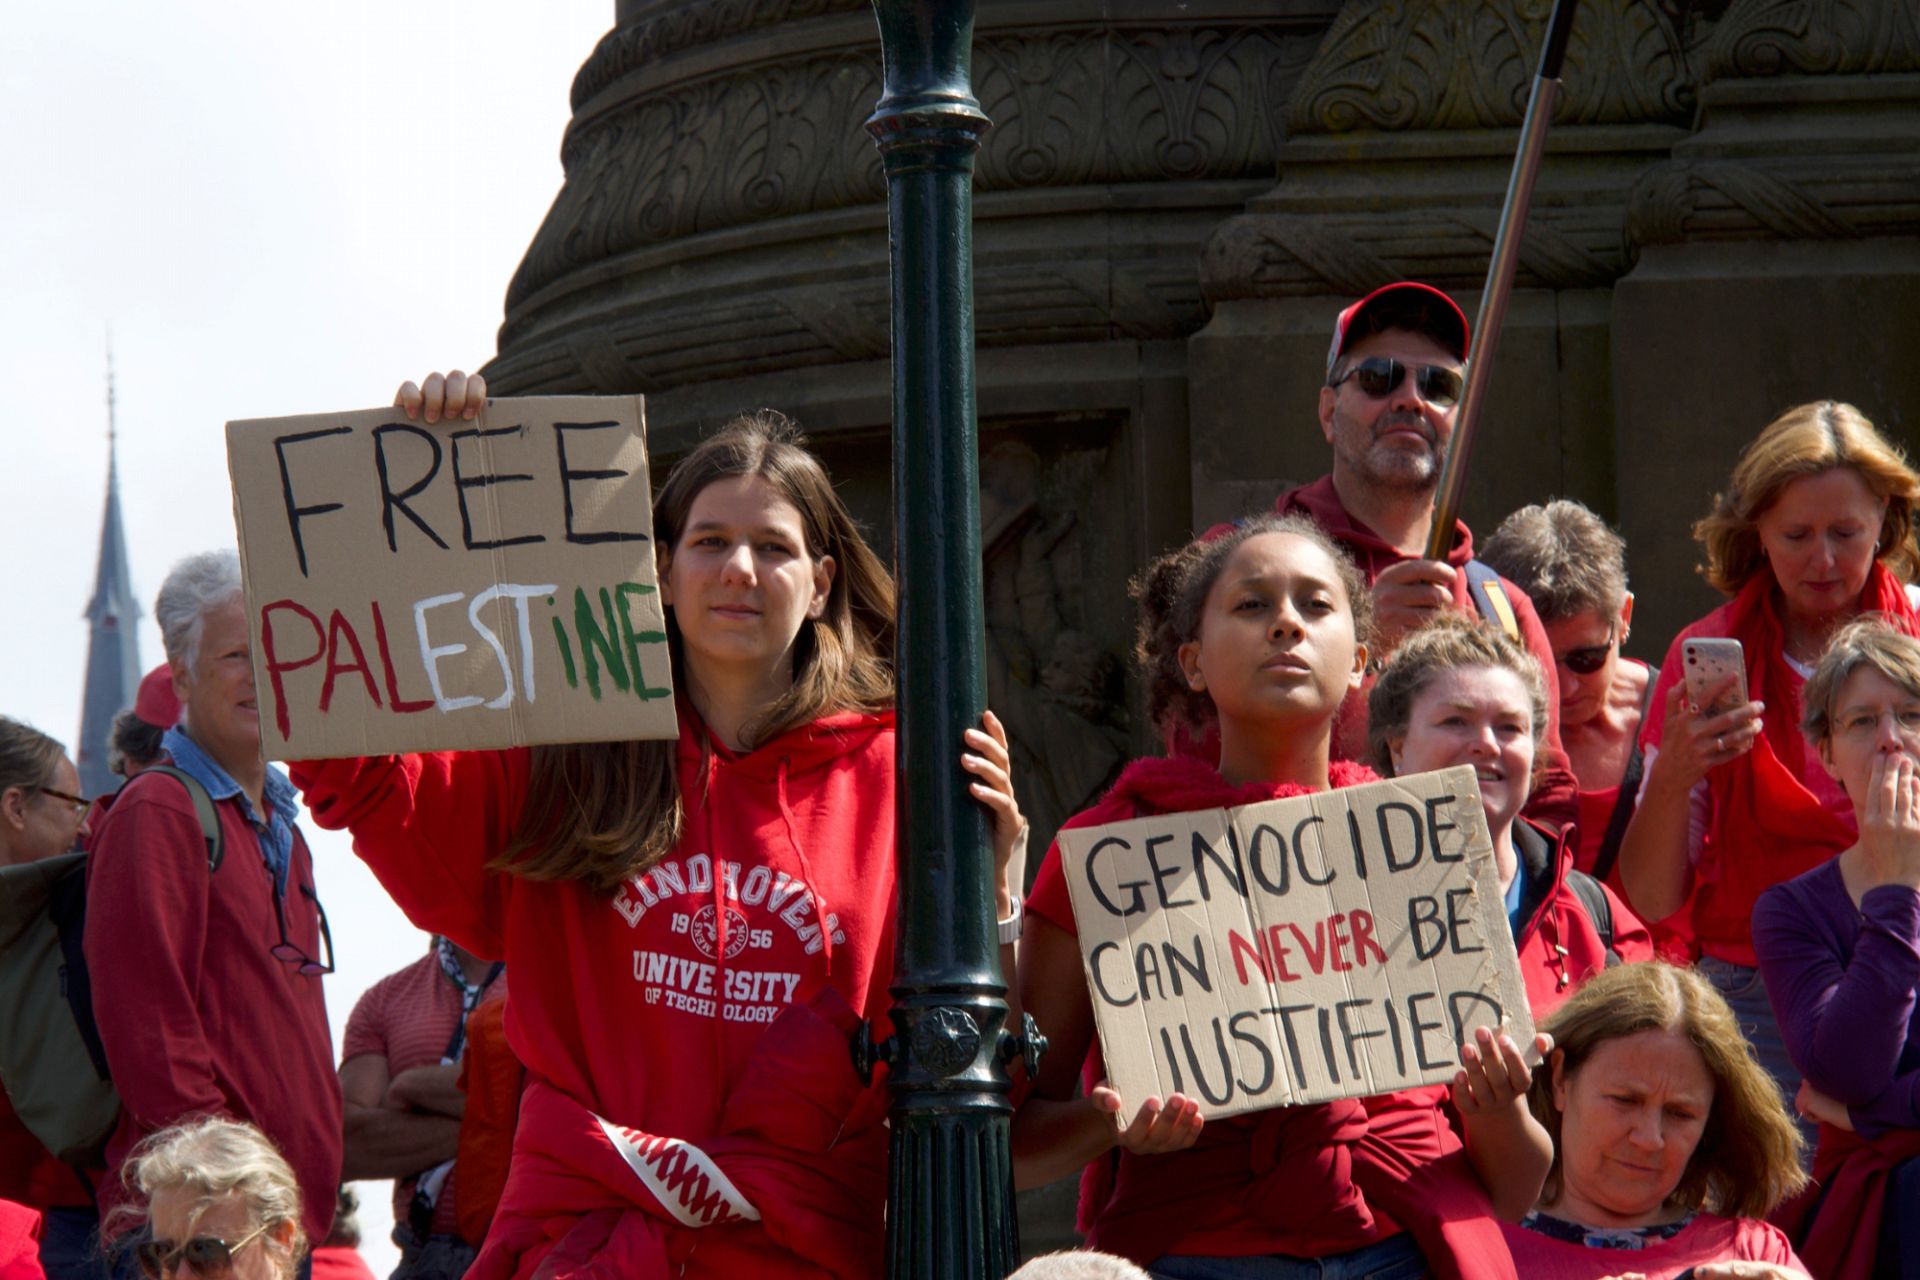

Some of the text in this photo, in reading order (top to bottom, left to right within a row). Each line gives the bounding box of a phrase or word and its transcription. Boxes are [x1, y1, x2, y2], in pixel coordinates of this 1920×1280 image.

[273, 420, 649, 578] FREE
[612, 853, 846, 956] EINDHOVEN
[1084, 795, 1467, 917] GENOCIDE
[671, 912, 774, 949] 19 56
[1089, 887, 1485, 1008] CAN NEVER BE
[645, 987, 662, 1005] OF
